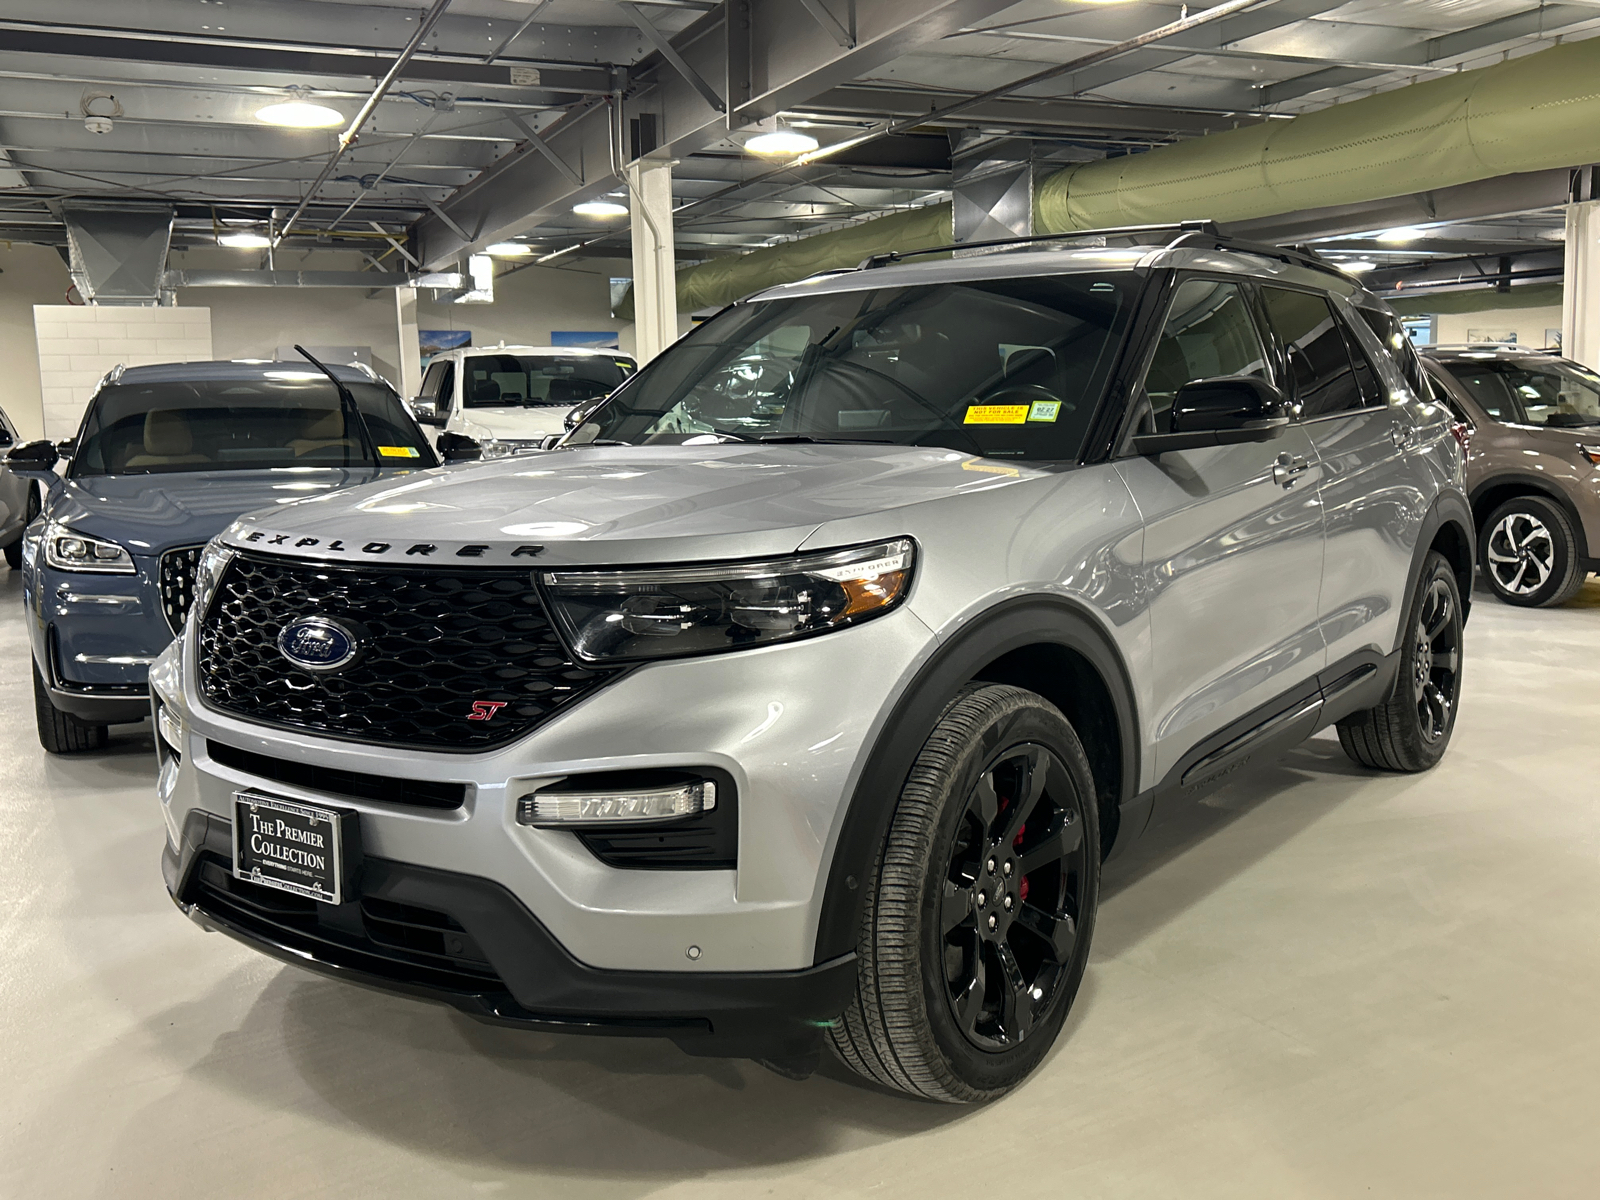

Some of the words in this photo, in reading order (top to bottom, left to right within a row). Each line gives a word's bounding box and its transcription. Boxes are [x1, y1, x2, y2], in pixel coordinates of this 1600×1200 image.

[246, 532, 545, 557] EXPLORER
[291, 627, 334, 658] Ford
[467, 701, 508, 720] ST
[249, 813, 275, 836] THE
[275, 819, 325, 849] PREMIER
[250, 834, 325, 871] COLLECTION
